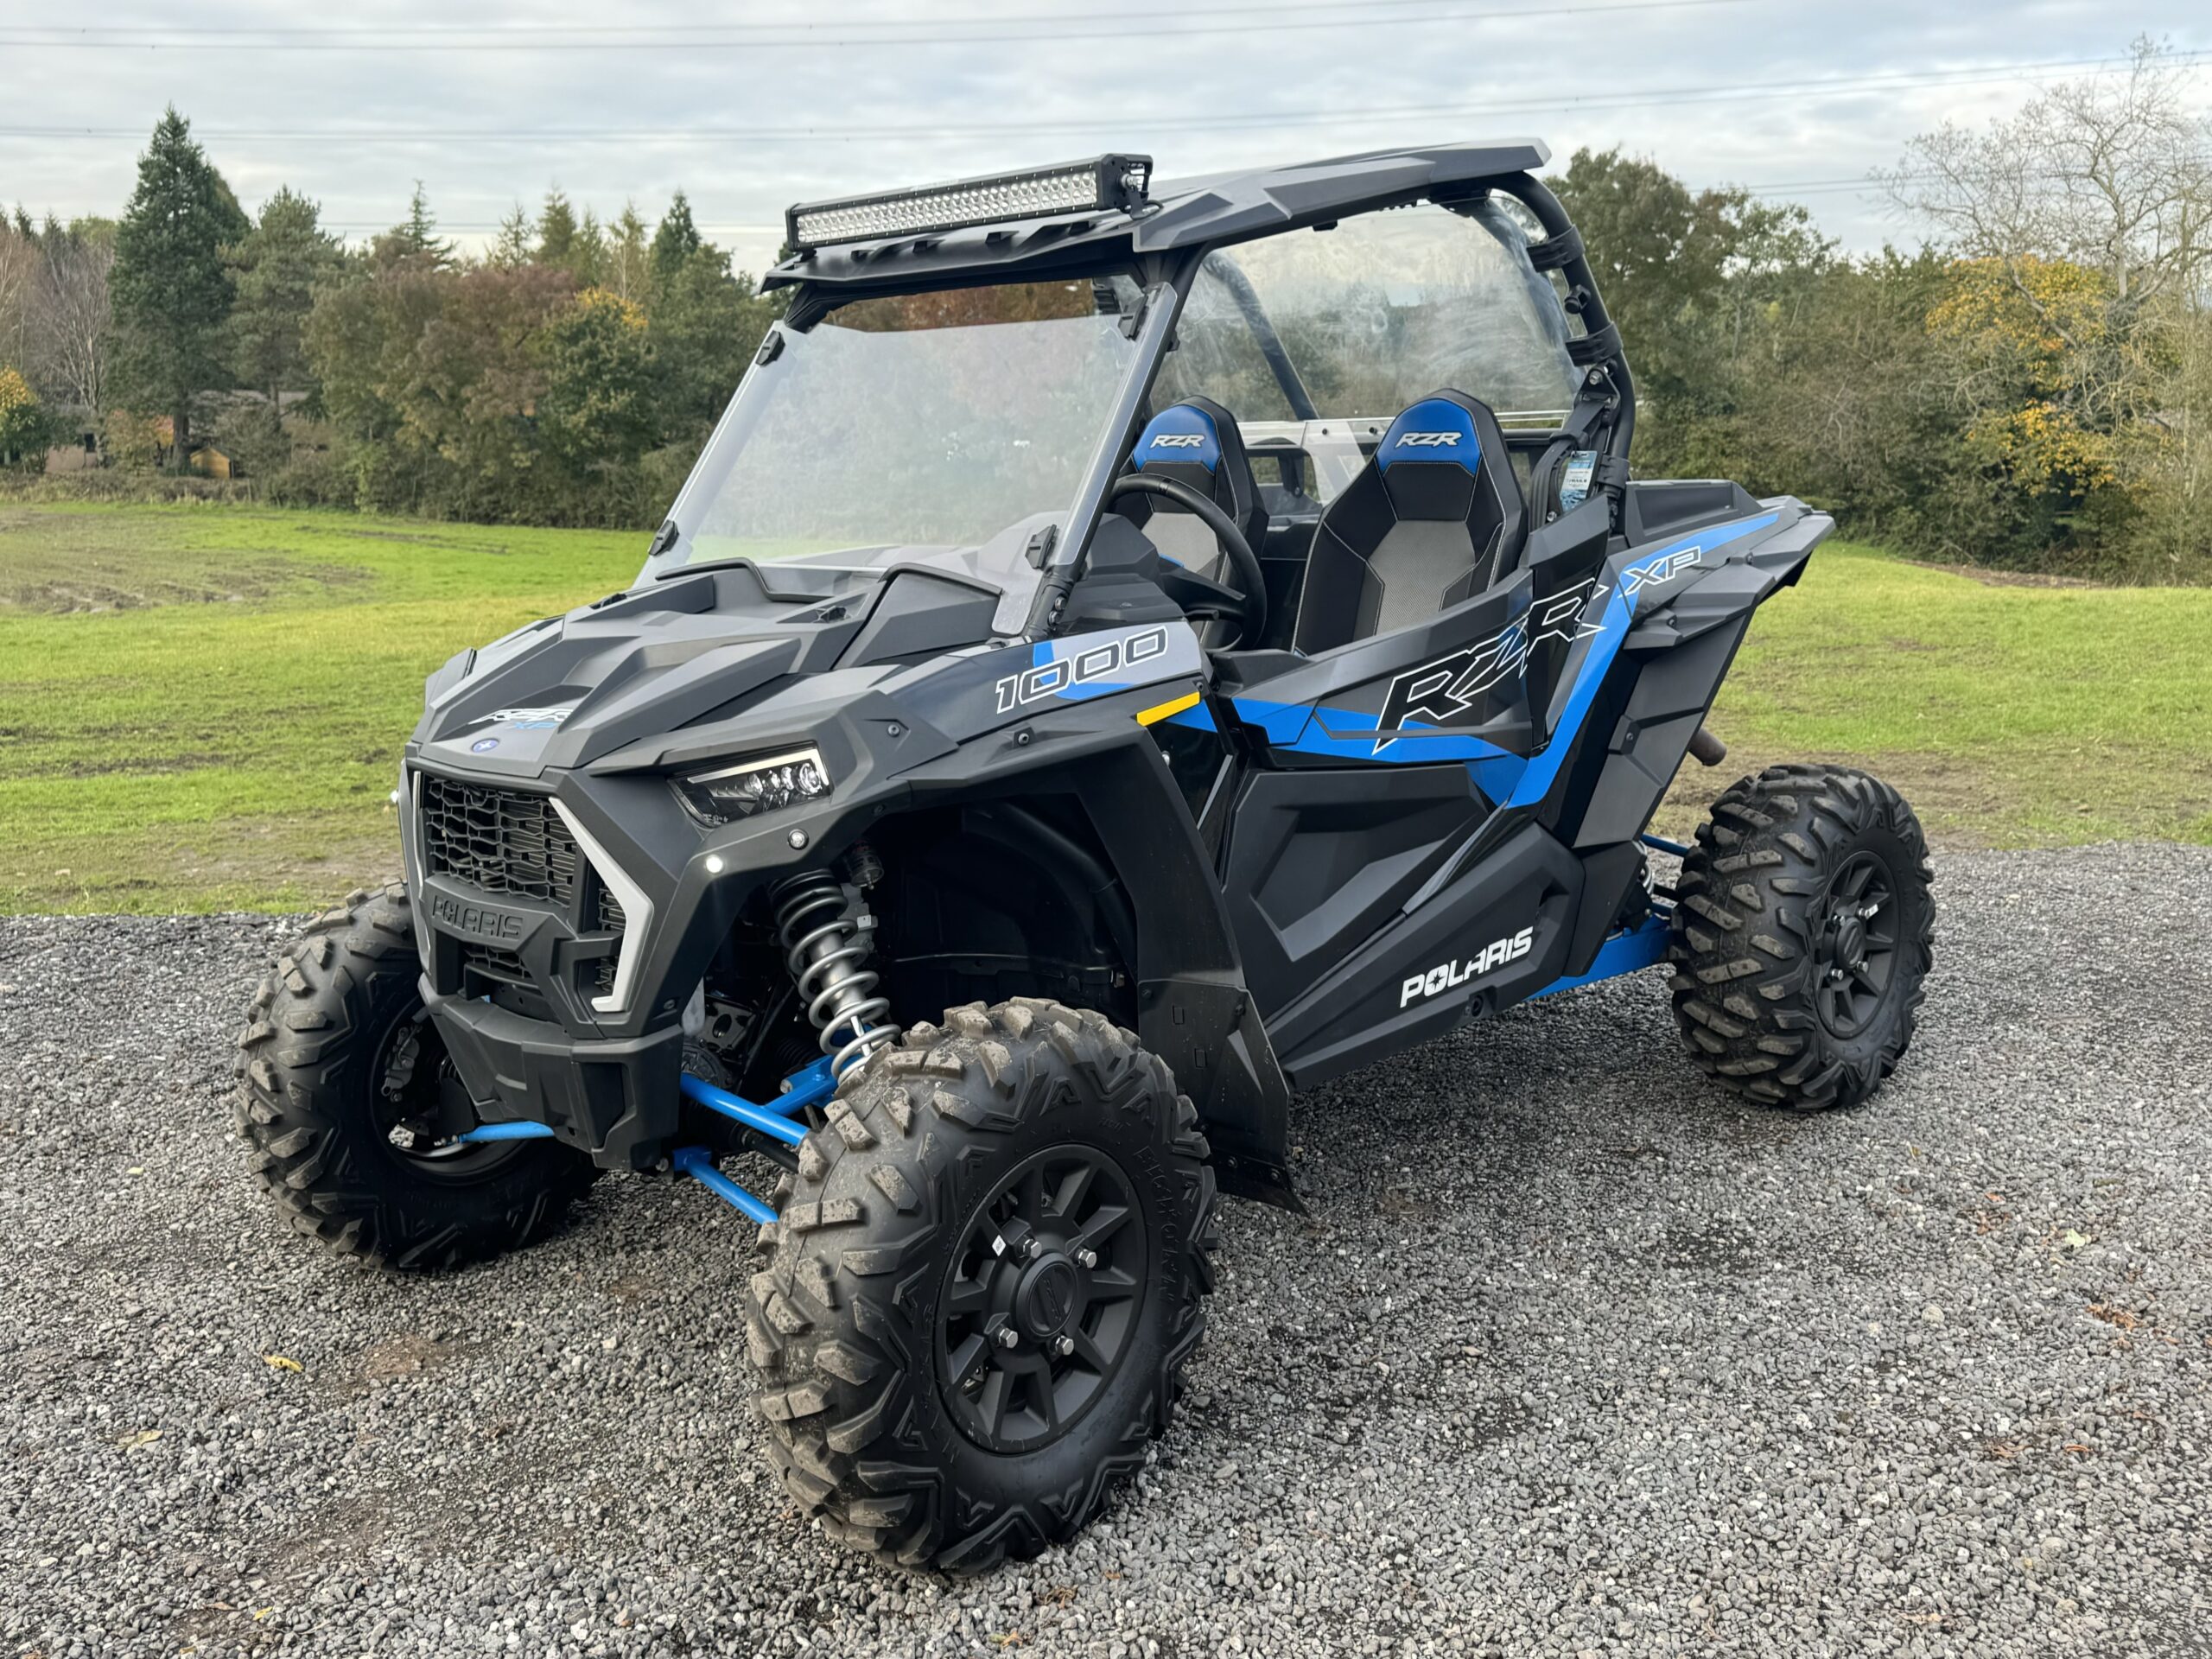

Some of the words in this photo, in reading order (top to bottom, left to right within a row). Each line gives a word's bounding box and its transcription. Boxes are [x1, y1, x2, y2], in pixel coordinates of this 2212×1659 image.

[1149, 434, 1206, 449] RZR
[1395, 431, 1462, 448] RZR
[995, 626, 1168, 715] 1000
[1371, 577, 1610, 756] RZR
[1618, 546, 1701, 598] XP
[432, 894, 523, 941] POLARIS
[1400, 925, 1534, 1008] POLARIS
